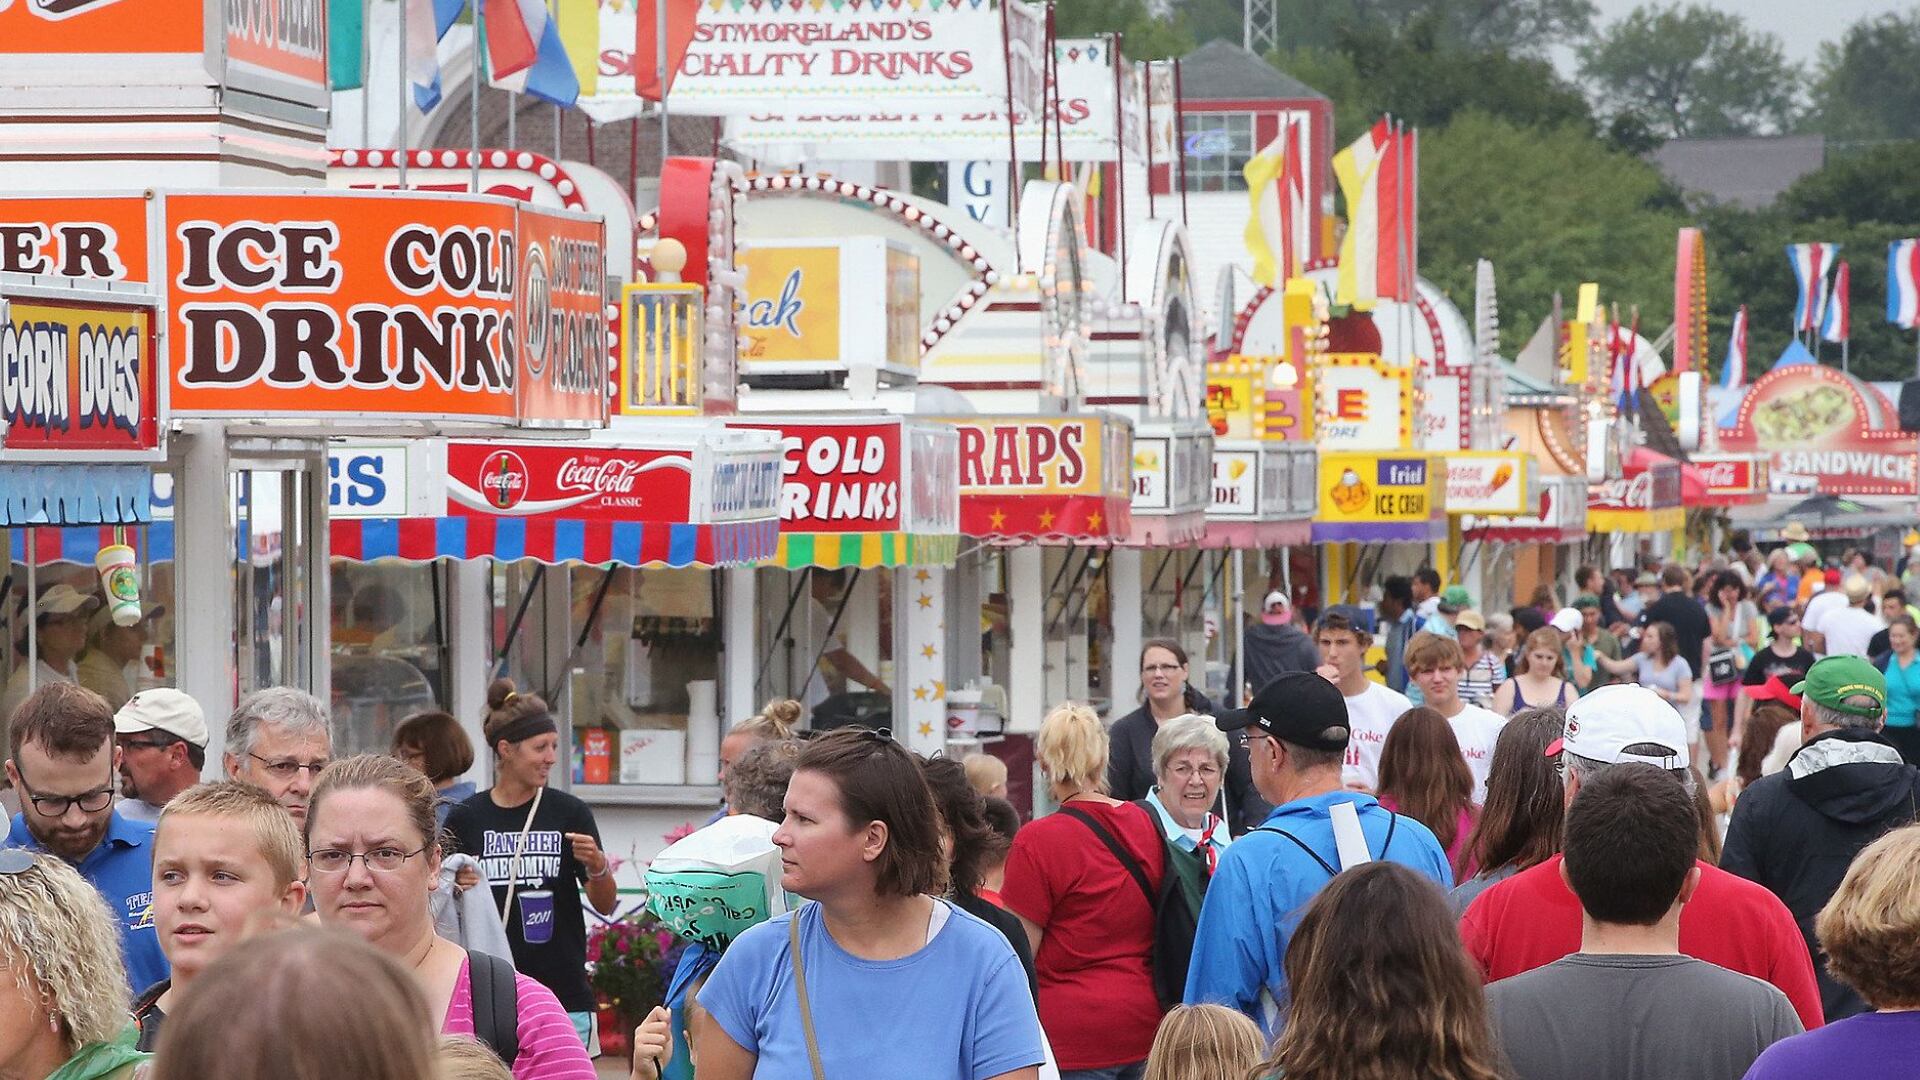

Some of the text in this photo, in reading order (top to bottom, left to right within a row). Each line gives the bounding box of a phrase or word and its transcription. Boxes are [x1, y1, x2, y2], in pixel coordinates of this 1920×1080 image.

[692, 20, 933, 45] STMORELAND'S
[598, 48, 818, 78] SCIALTY
[830, 48, 974, 81] DRINKS
[0, 225, 115, 277] ER
[181, 225, 515, 295] ICE COLD
[739, 269, 804, 337] ak
[184, 308, 515, 391] DRINKS
[551, 307, 602, 396] FLOATS
[2, 322, 140, 438] CORN DOGS
[782, 435, 886, 475] COLD
[957, 425, 1084, 487] RAPS
[556, 456, 641, 494] Coca-Cola
[600, 495, 643, 508] CLASSIC
[781, 480, 899, 521] RINKS
[1375, 494, 1395, 515] ICE
[1351, 727, 1383, 743] Coke
[1461, 746, 1486, 759] oke
[483, 830, 562, 856] PANHER
[478, 855, 562, 880] OMEOMING
[126, 891, 153, 911] TE
[526, 910, 552, 926] 2011
